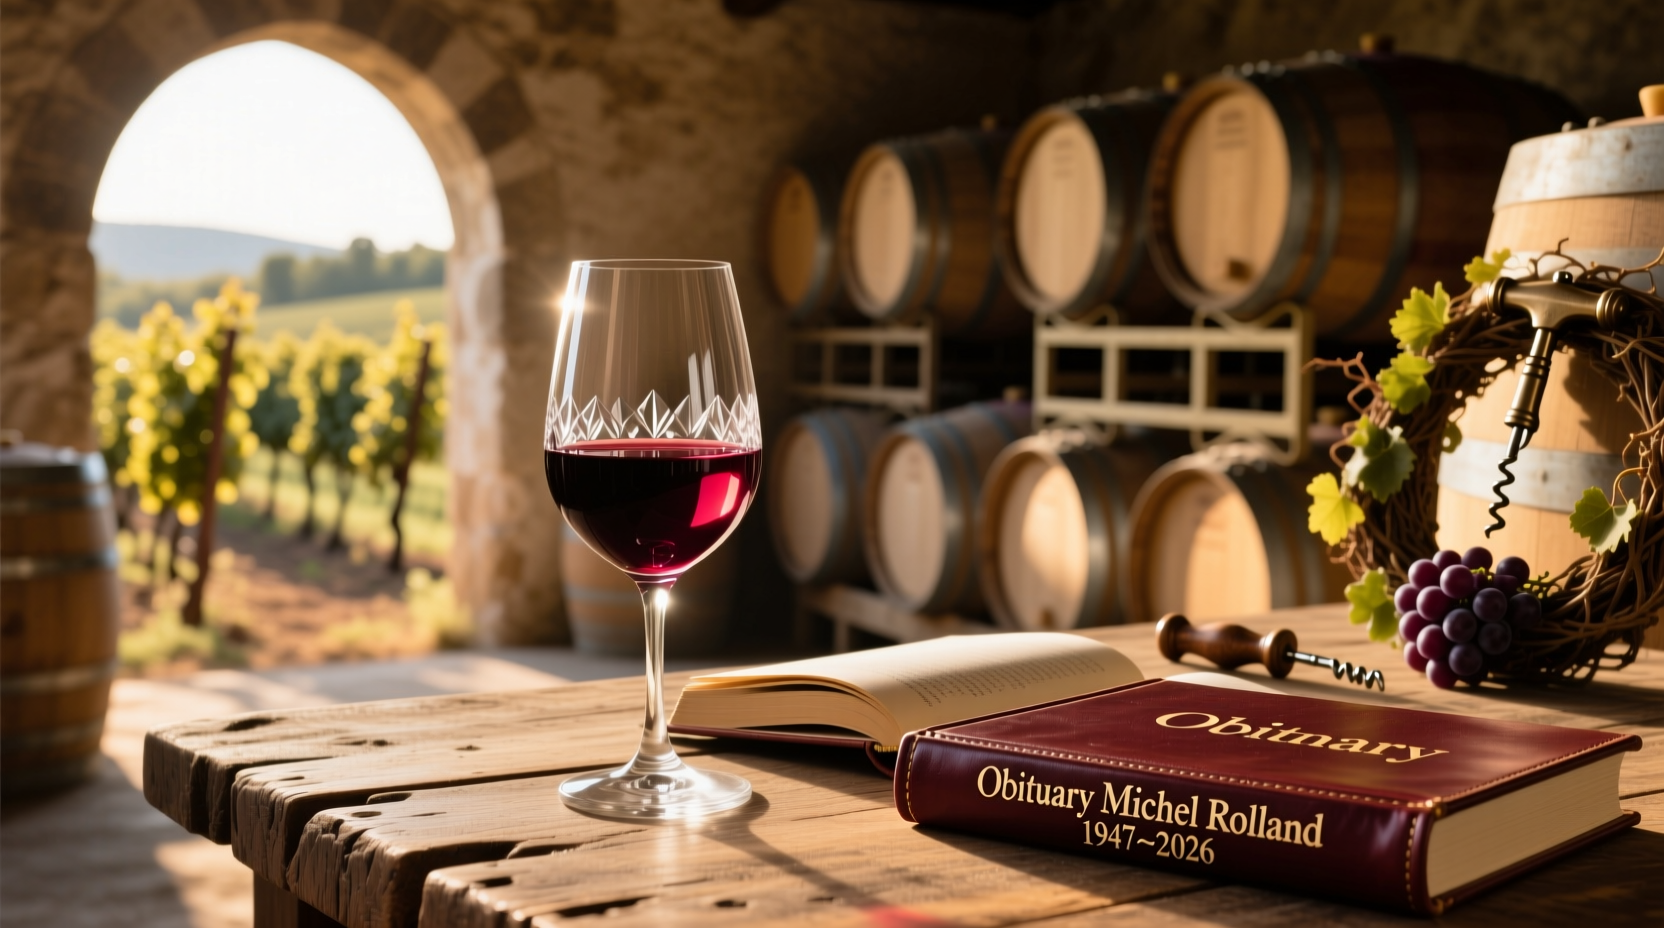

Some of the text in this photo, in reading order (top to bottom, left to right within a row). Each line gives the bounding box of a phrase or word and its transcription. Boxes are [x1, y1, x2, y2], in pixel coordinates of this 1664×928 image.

[977, 765, 1324, 848] Obituary Michel Rolland
